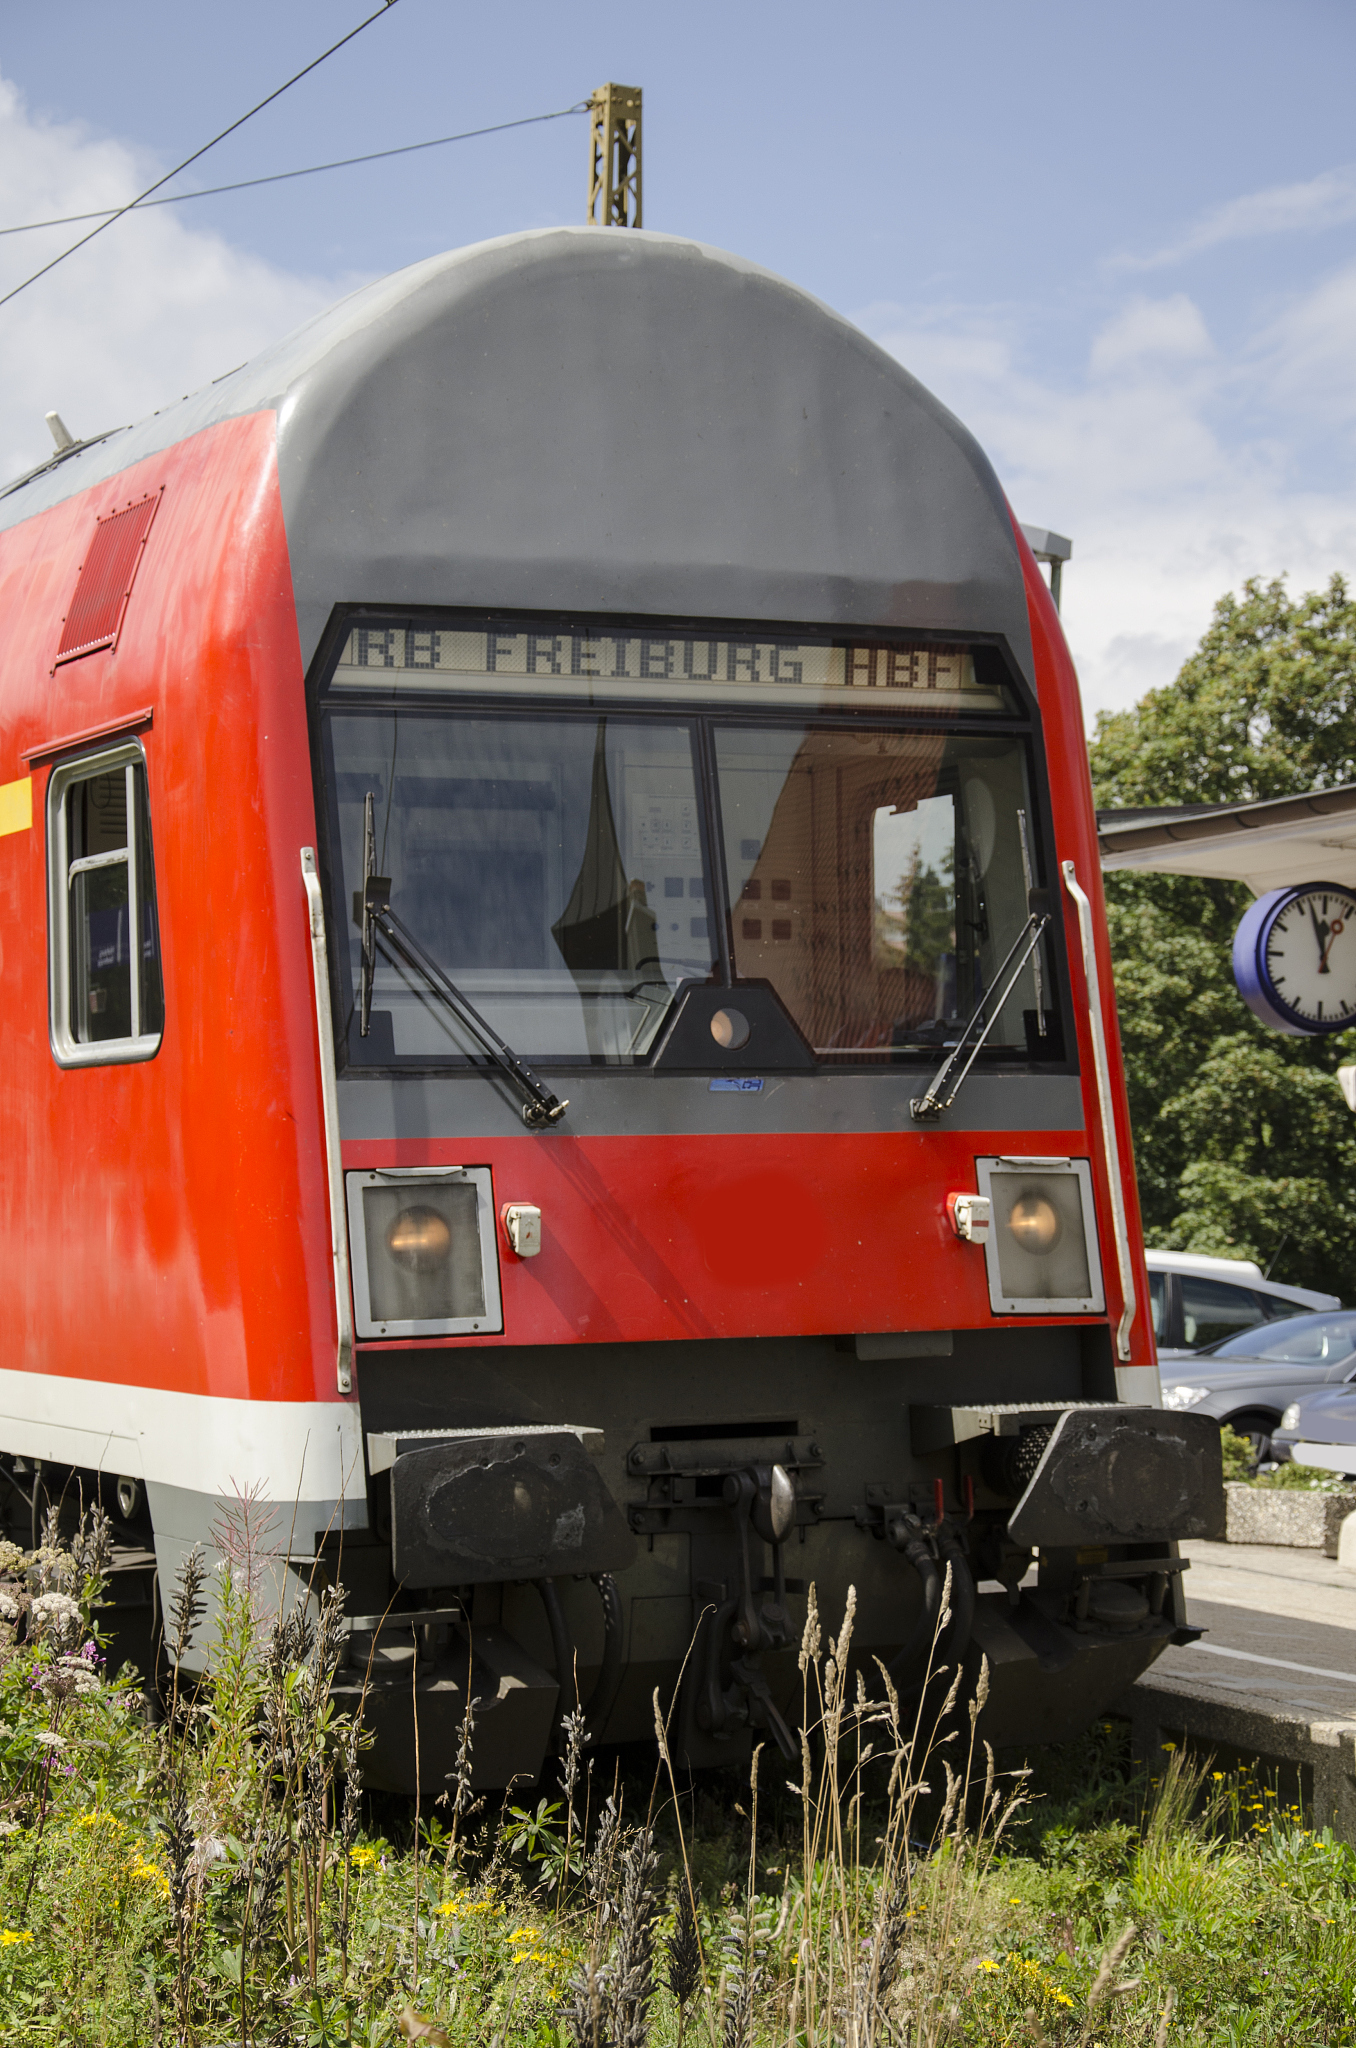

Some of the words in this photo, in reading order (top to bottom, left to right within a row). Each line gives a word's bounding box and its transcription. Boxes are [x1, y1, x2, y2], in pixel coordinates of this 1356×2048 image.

[357, 628, 440, 669] RB
[487, 631, 801, 684] FREIBURG
[845, 647, 956, 688] HBF
